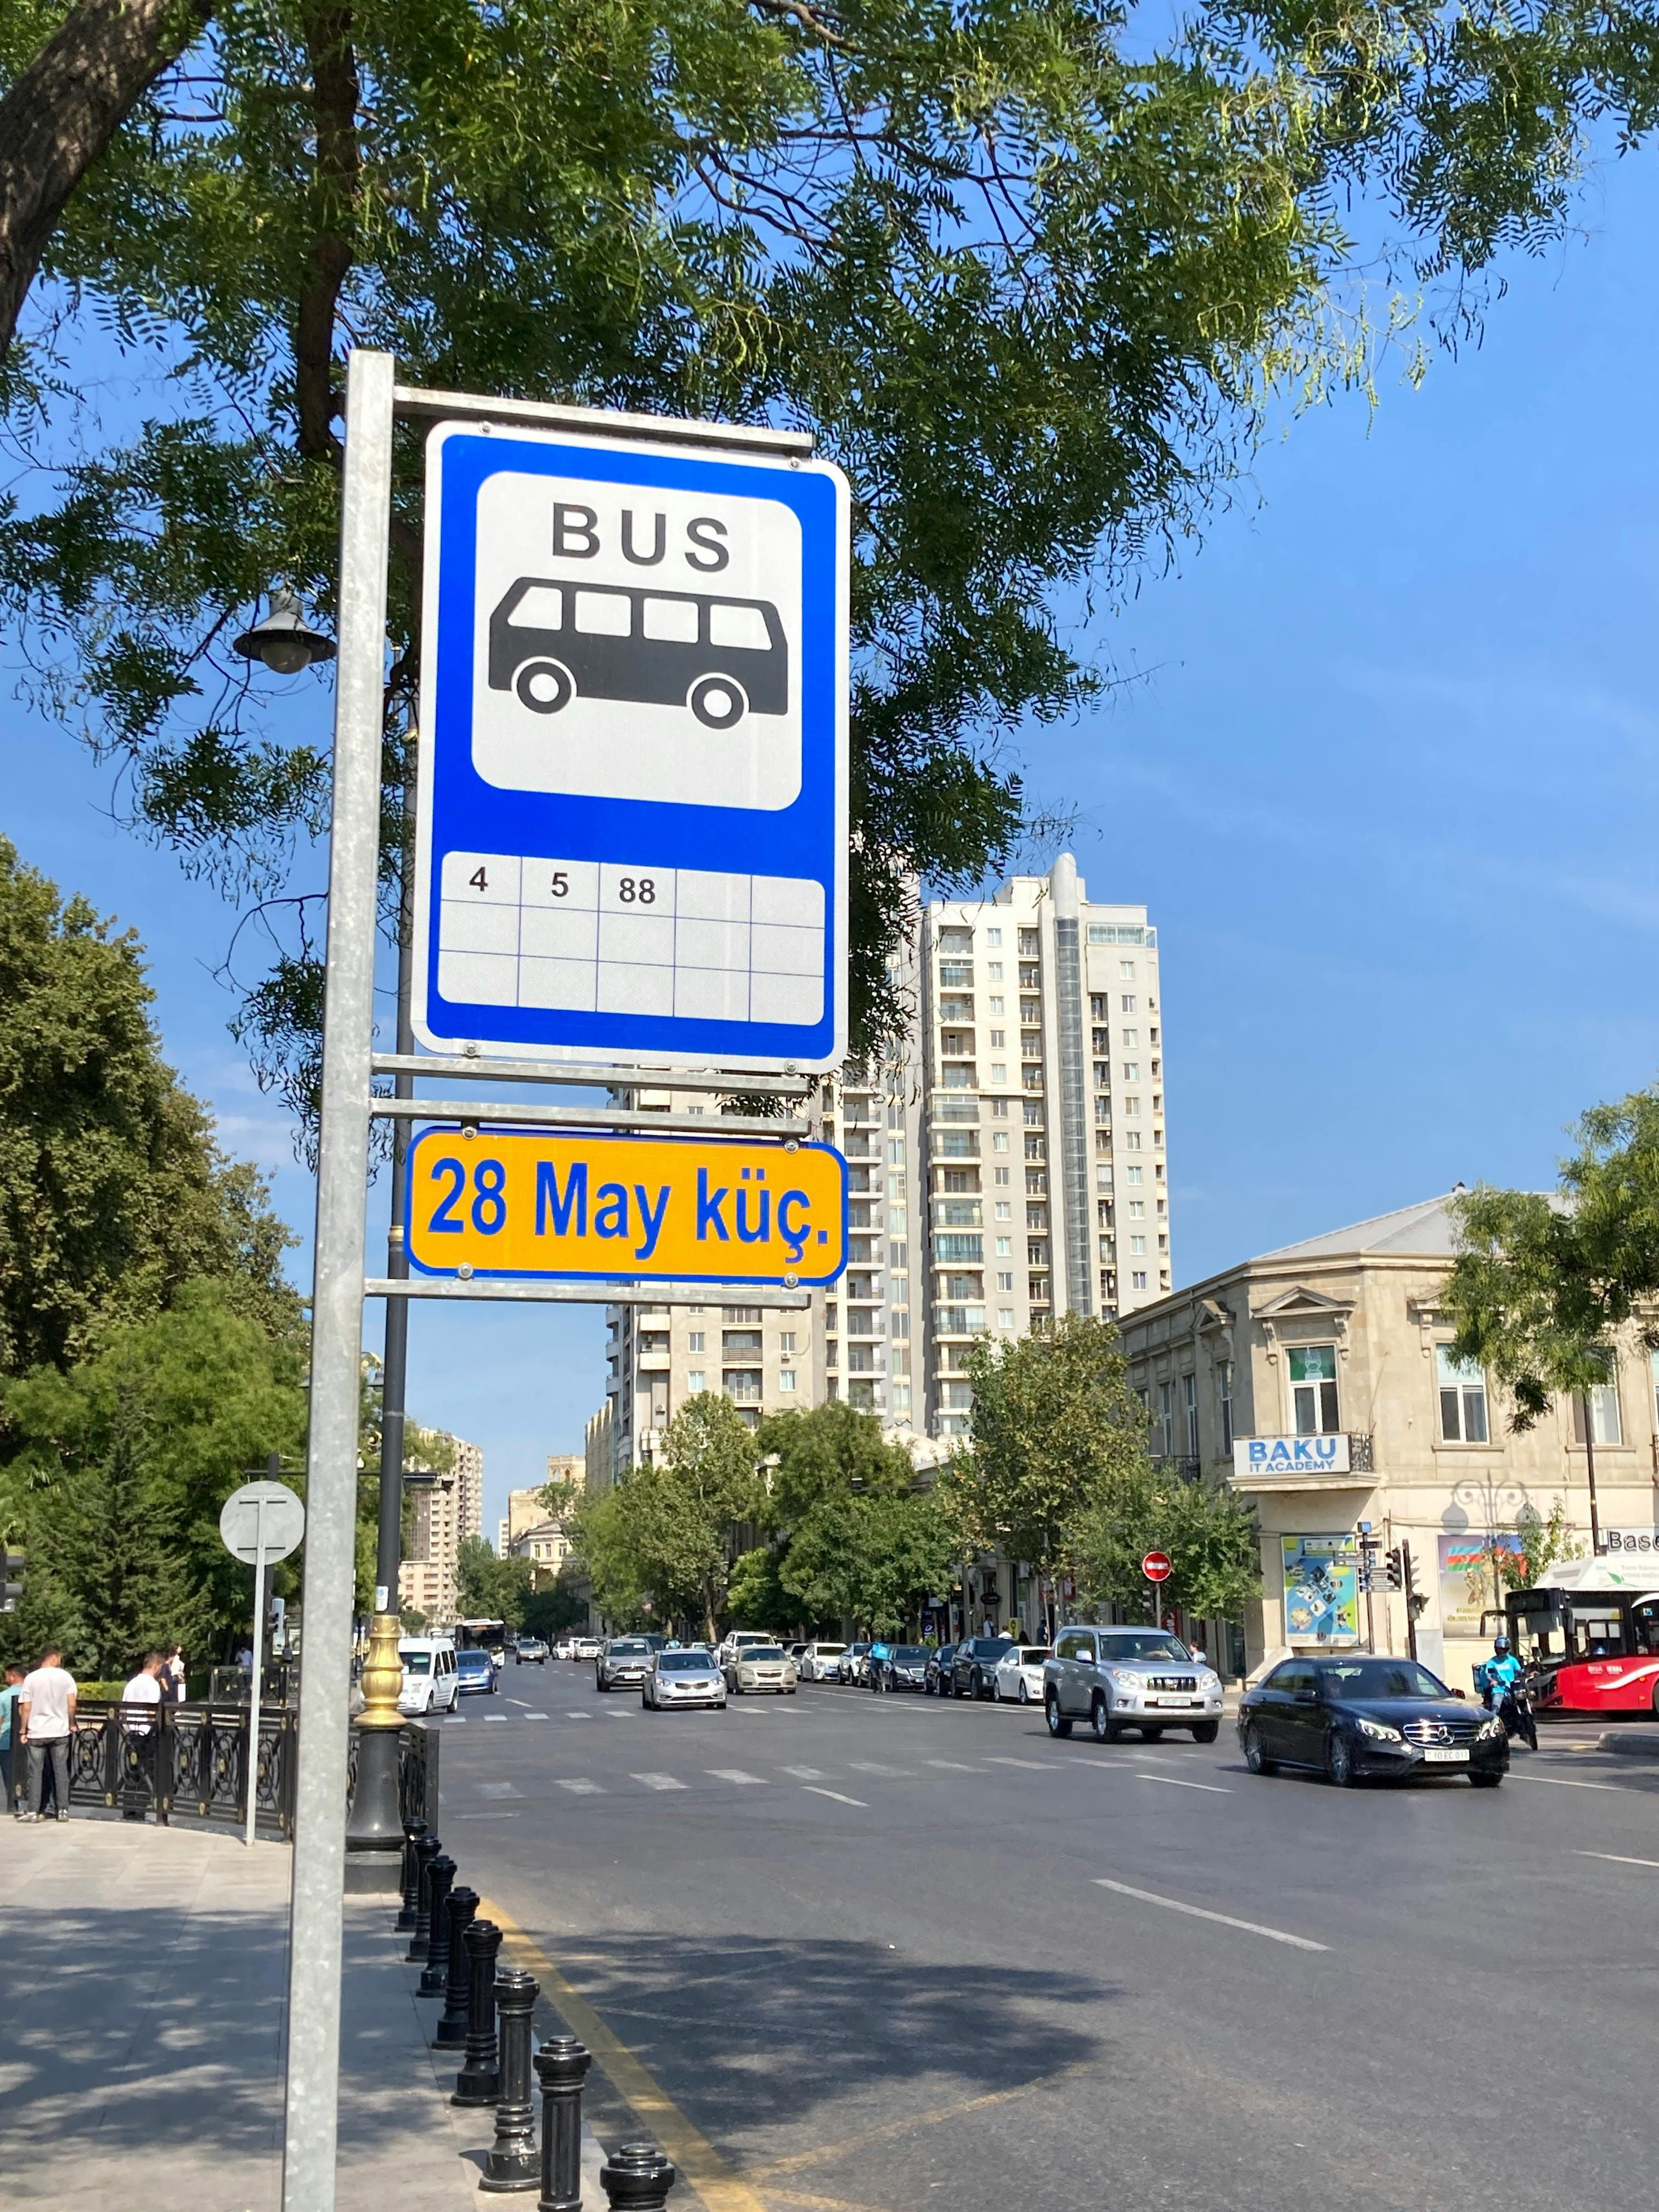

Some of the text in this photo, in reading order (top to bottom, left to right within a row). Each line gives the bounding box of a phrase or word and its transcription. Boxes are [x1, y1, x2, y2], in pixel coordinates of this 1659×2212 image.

[552, 502, 729, 573] BUS
[469, 867, 656, 904] 4 5 88
[427, 1158, 828, 1264] 28 May küç.
[1249, 1438, 1336, 1462] BAKU
[1250, 1460, 1334, 1472] IT ACADEMY
